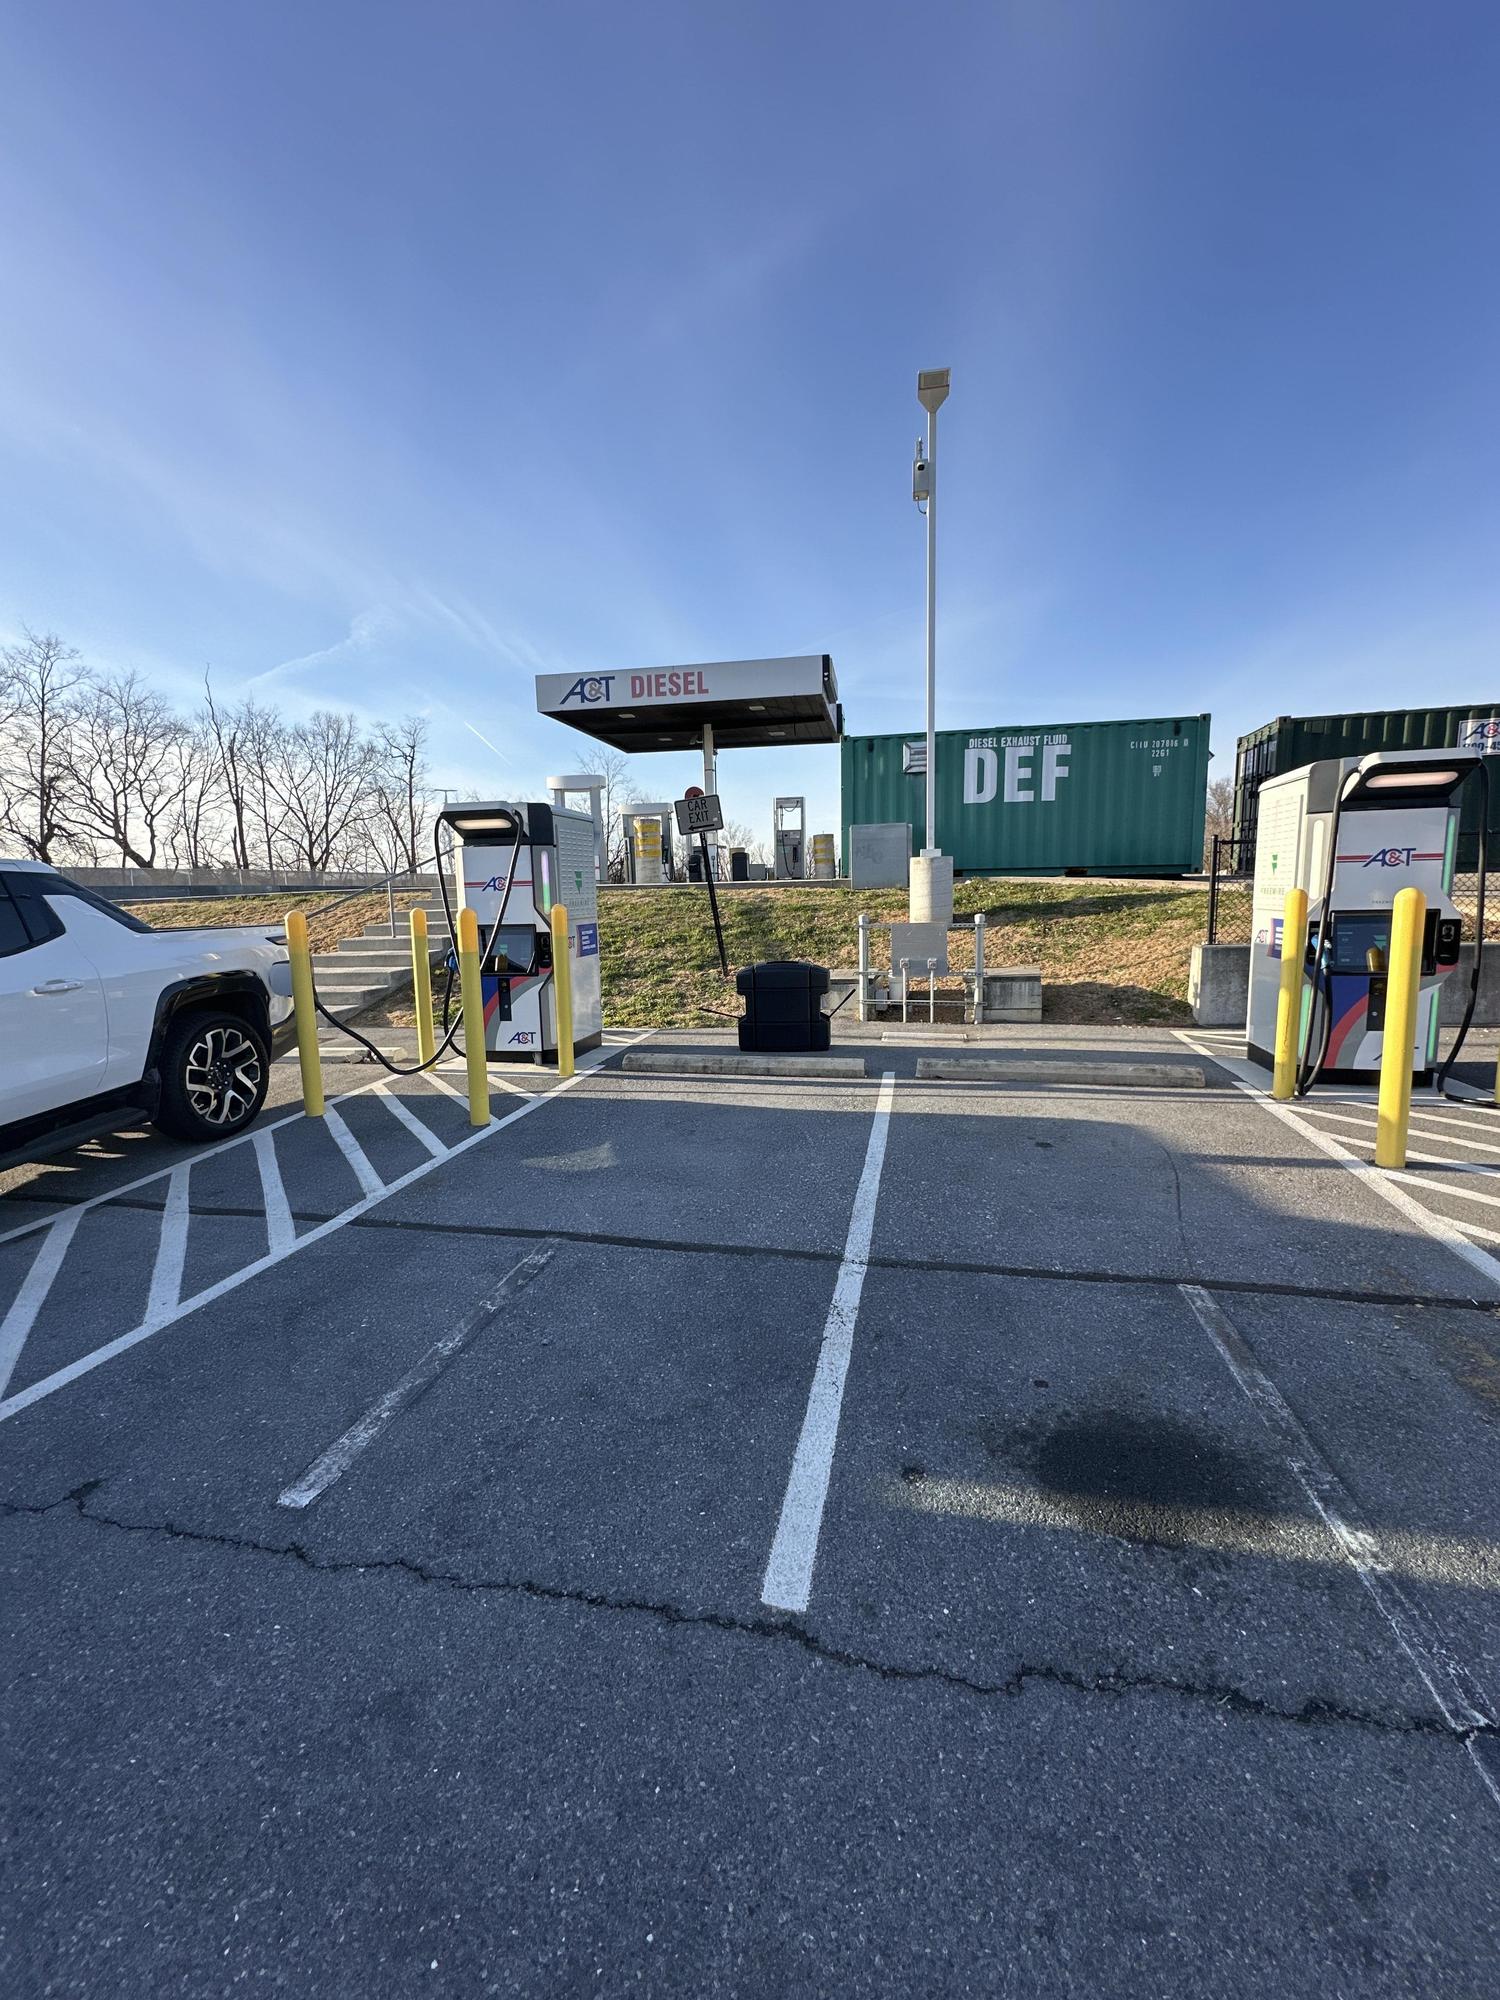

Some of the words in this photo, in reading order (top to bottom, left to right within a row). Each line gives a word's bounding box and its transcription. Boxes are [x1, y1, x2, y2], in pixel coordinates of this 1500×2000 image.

[630, 671, 709, 699] DIESEL
[1463, 720, 1500, 741] AC&
[968, 737, 998, 749] DIESEL
[1000, 735, 1041, 748] EXHAUST
[1043, 733, 1068, 746] FLUID
[963, 743, 1072, 804] DEF
[687, 799, 708, 812] CAR
[688, 810, 709, 823] EXIT
[481, 876, 508, 892] AC&
